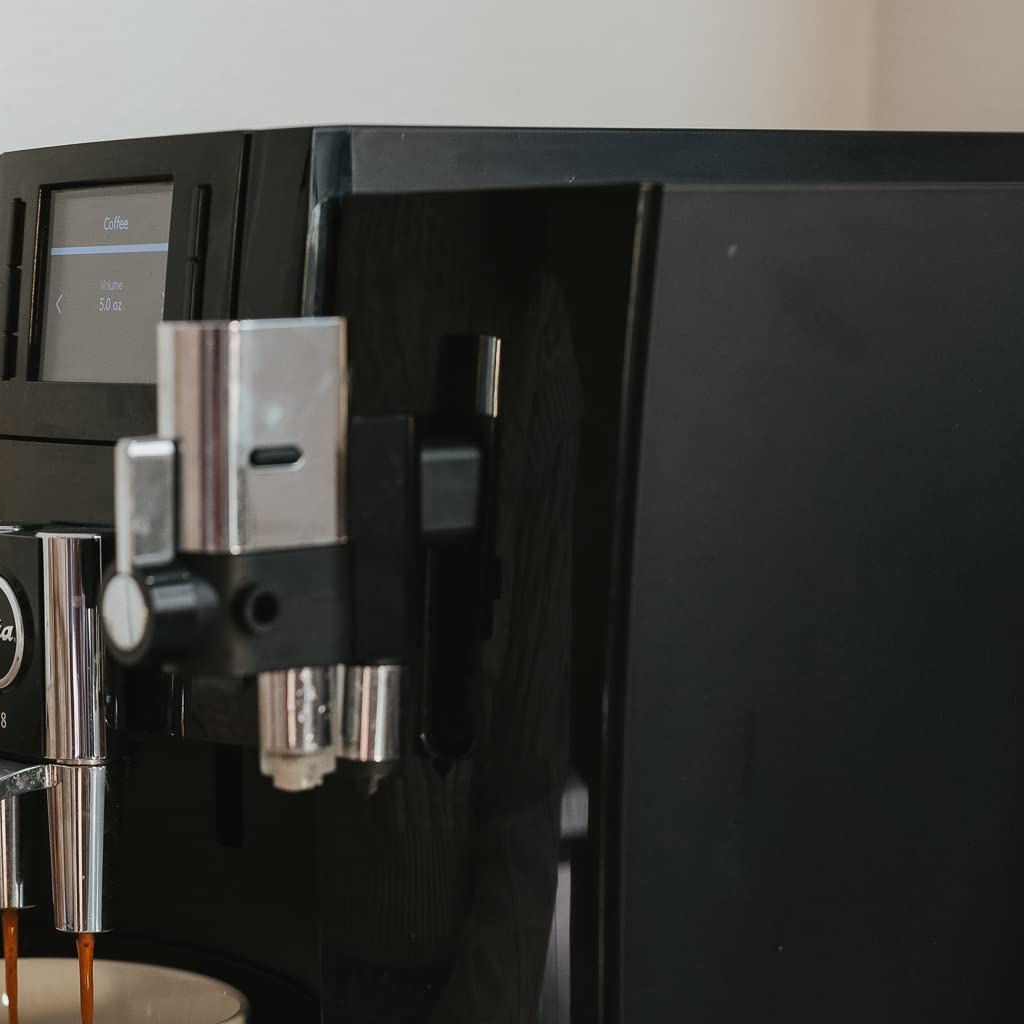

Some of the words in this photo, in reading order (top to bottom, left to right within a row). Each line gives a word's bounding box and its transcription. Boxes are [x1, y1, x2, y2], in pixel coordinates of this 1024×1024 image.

[103, 216, 129, 231] Coffee
[99, 280, 124, 291] Volume
[98, 297, 112, 312] 5.0
[112, 300, 122, 312] oz
